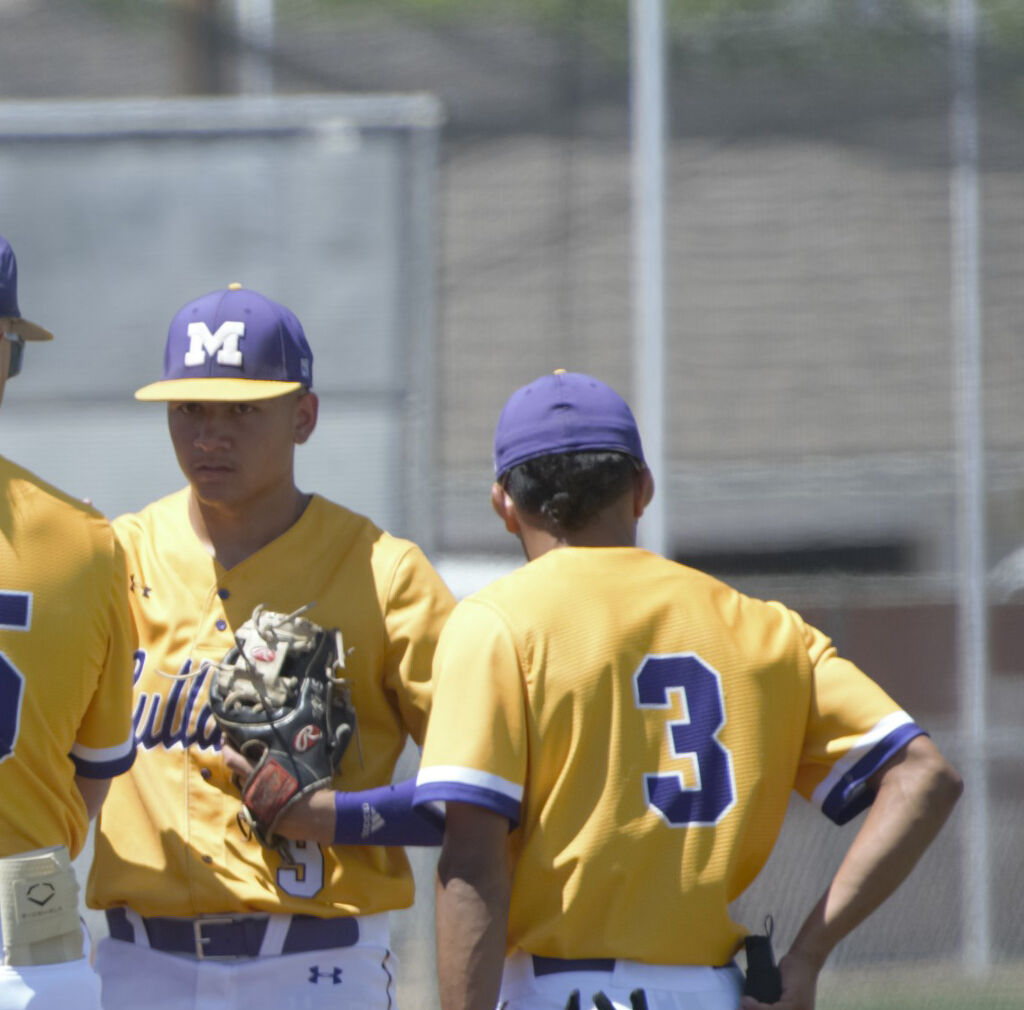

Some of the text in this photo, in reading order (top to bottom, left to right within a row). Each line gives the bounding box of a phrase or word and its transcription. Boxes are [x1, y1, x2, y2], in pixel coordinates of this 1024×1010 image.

[184, 320, 245, 367] M
[631, 651, 738, 829] 3
[276, 839, 325, 899] 9
